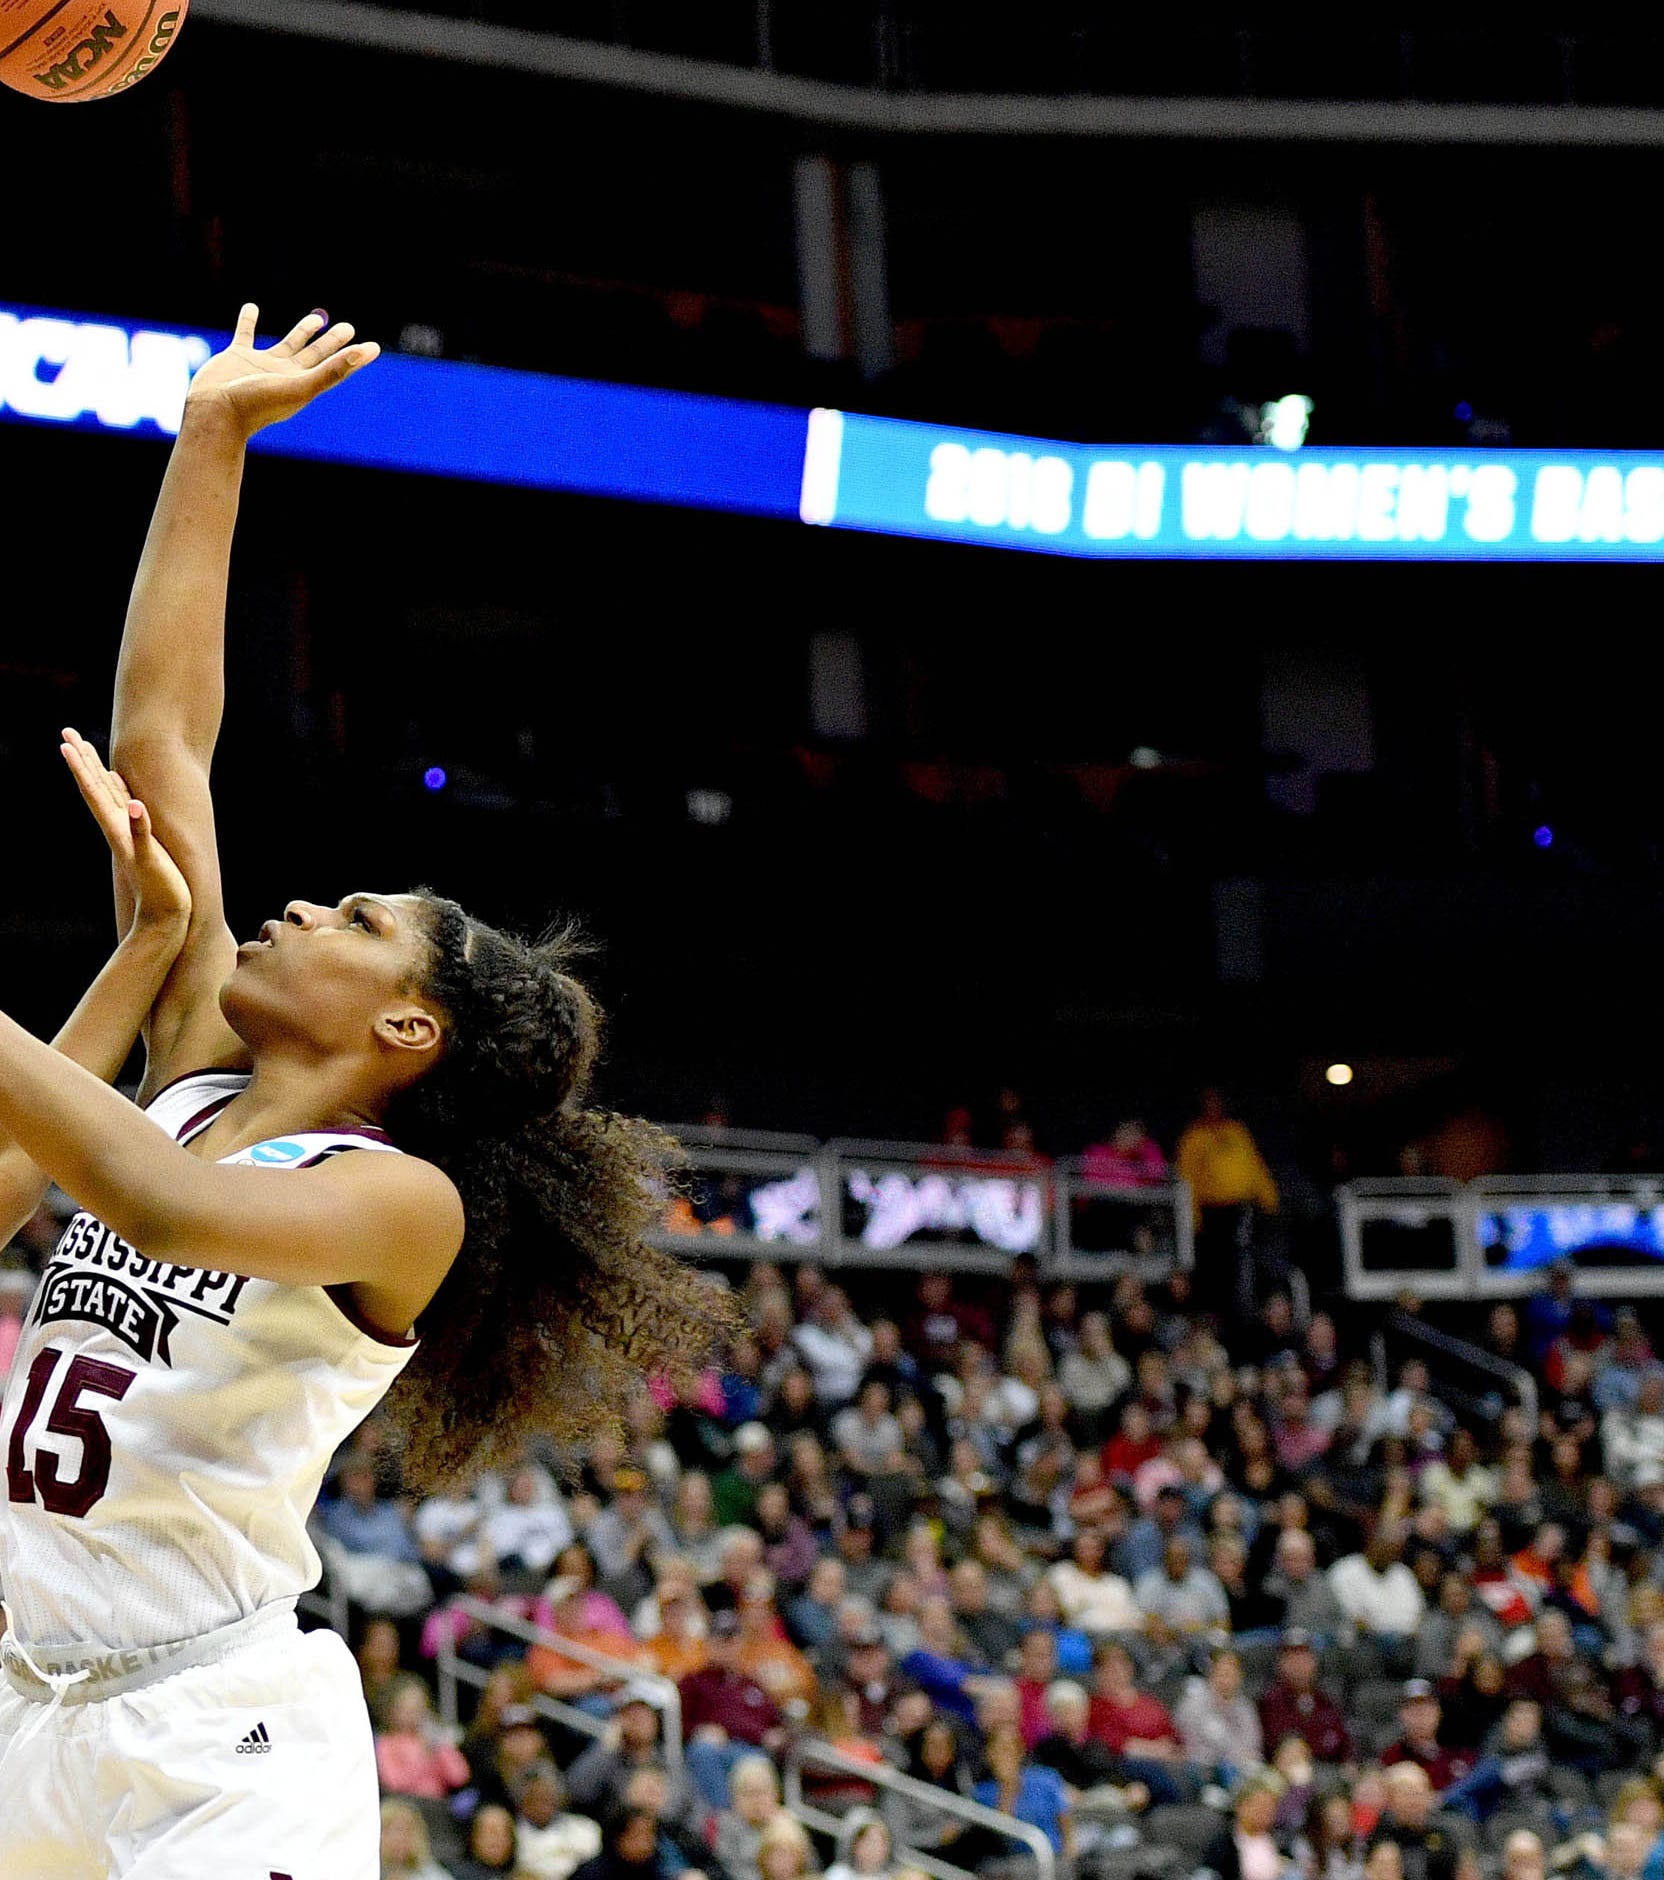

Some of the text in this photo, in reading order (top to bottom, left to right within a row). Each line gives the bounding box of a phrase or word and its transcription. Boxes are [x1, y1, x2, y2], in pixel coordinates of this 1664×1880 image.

[33, 9, 128, 89] NCAA
[1182, 462, 1518, 542] WOMEN'S
[47, 1279, 146, 1344] STATE
[6, 1346, 138, 1519] 15
